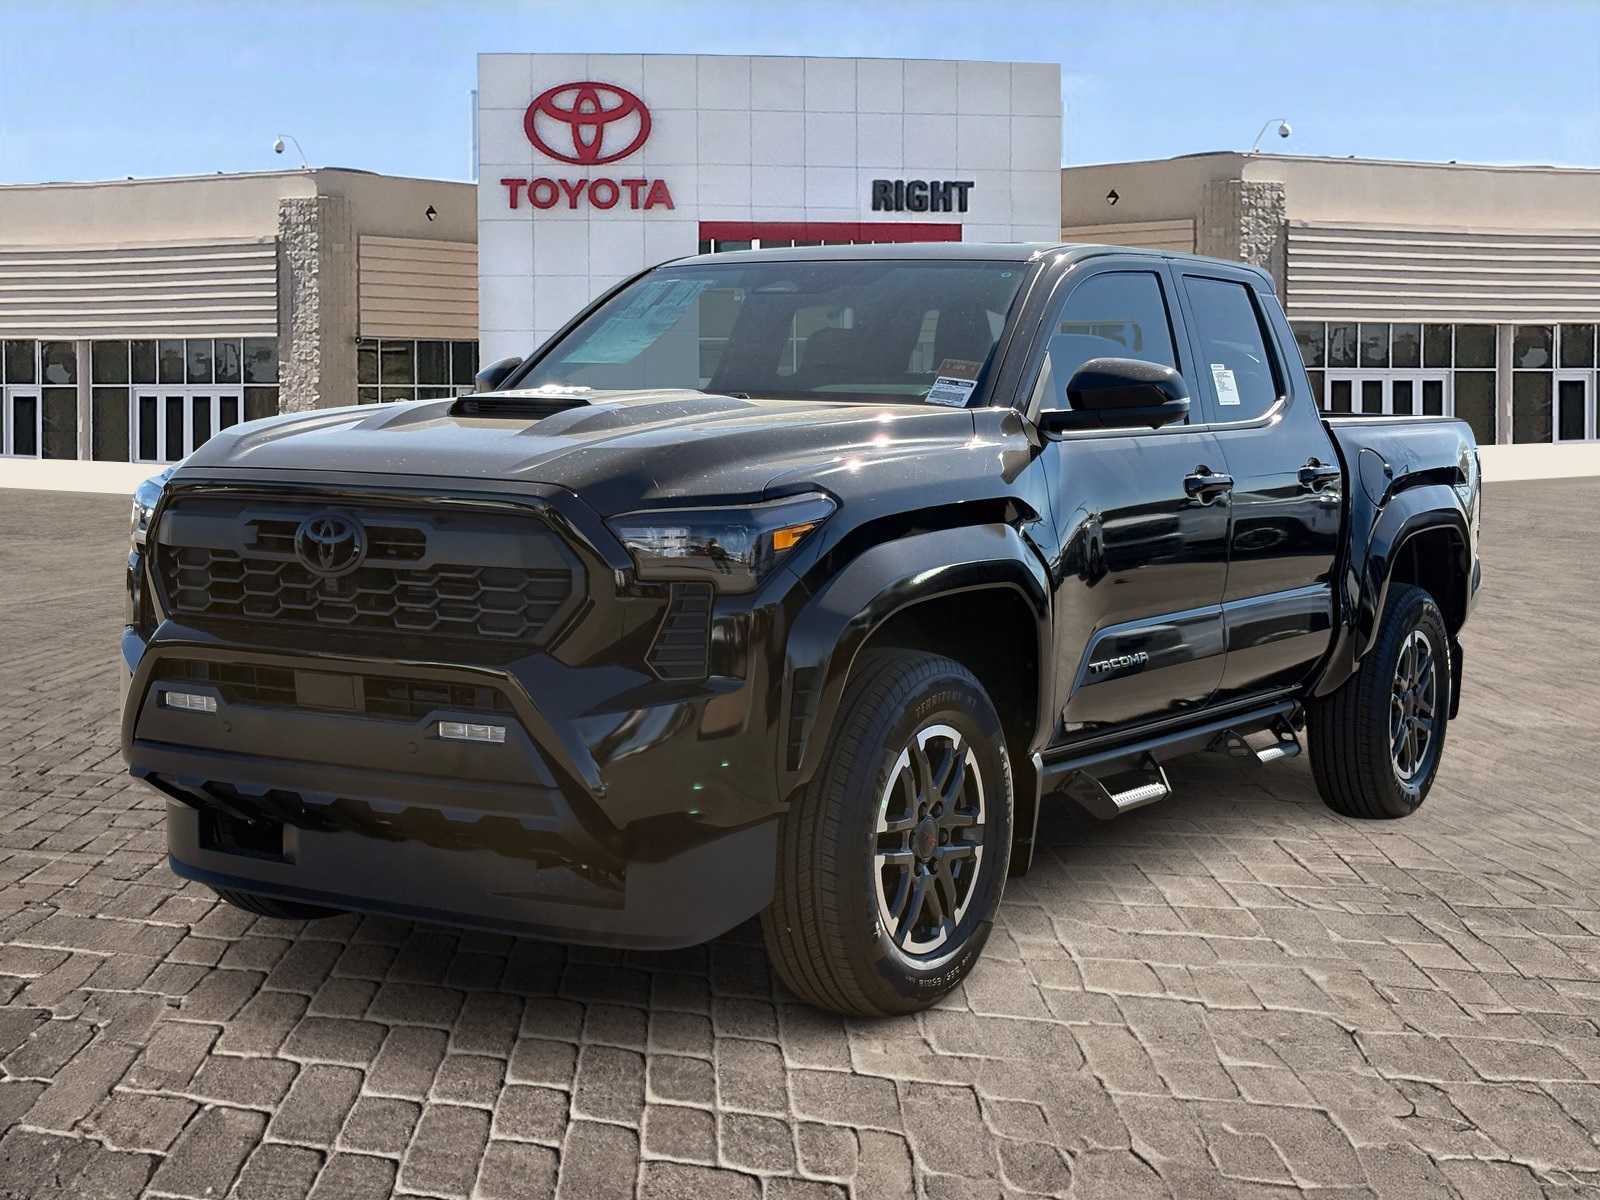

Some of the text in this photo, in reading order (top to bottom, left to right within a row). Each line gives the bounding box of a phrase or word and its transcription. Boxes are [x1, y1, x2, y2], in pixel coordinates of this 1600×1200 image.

[501, 178, 674, 210] TOYOTA
[872, 180, 975, 213] RIGHT
[1088, 651, 1149, 674] TACOMA
